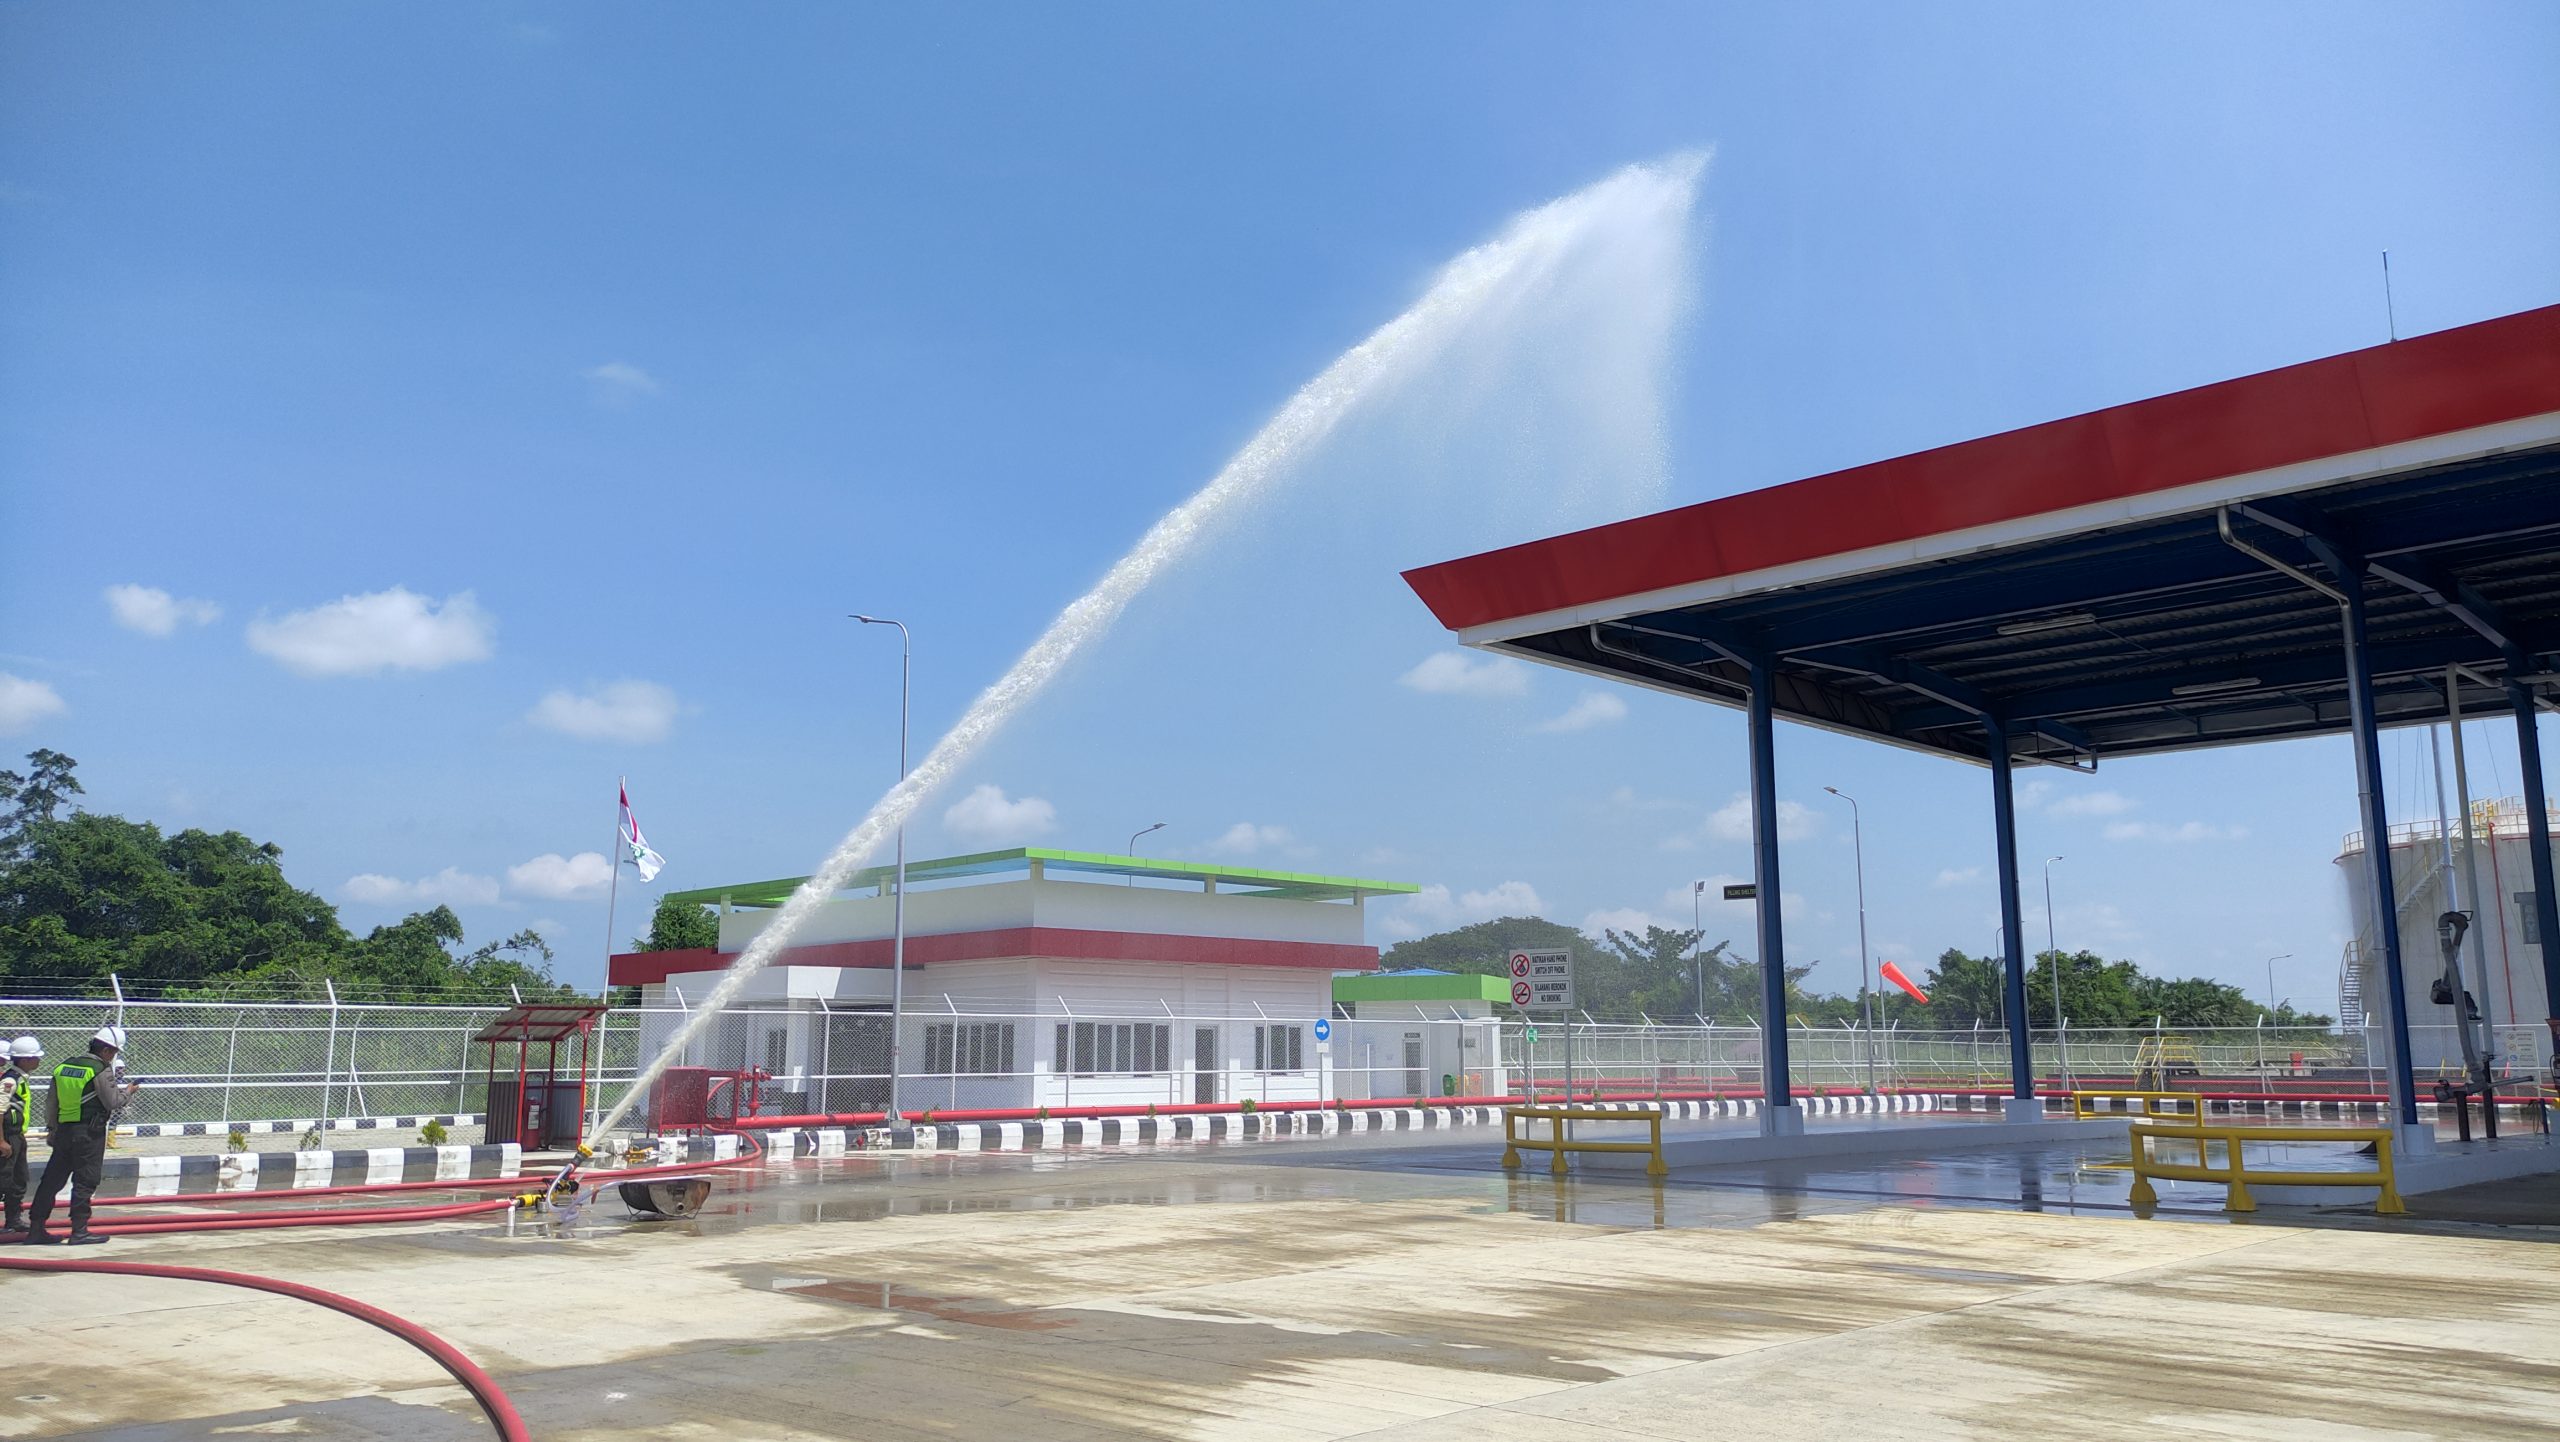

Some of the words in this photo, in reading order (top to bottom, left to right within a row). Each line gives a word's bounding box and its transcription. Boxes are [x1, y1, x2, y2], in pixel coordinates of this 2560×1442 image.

[1547, 955, 1555, 963] HAND
[1556, 954, 1567, 962] PHONE
[1551, 983, 1566, 991] MEROKOK
